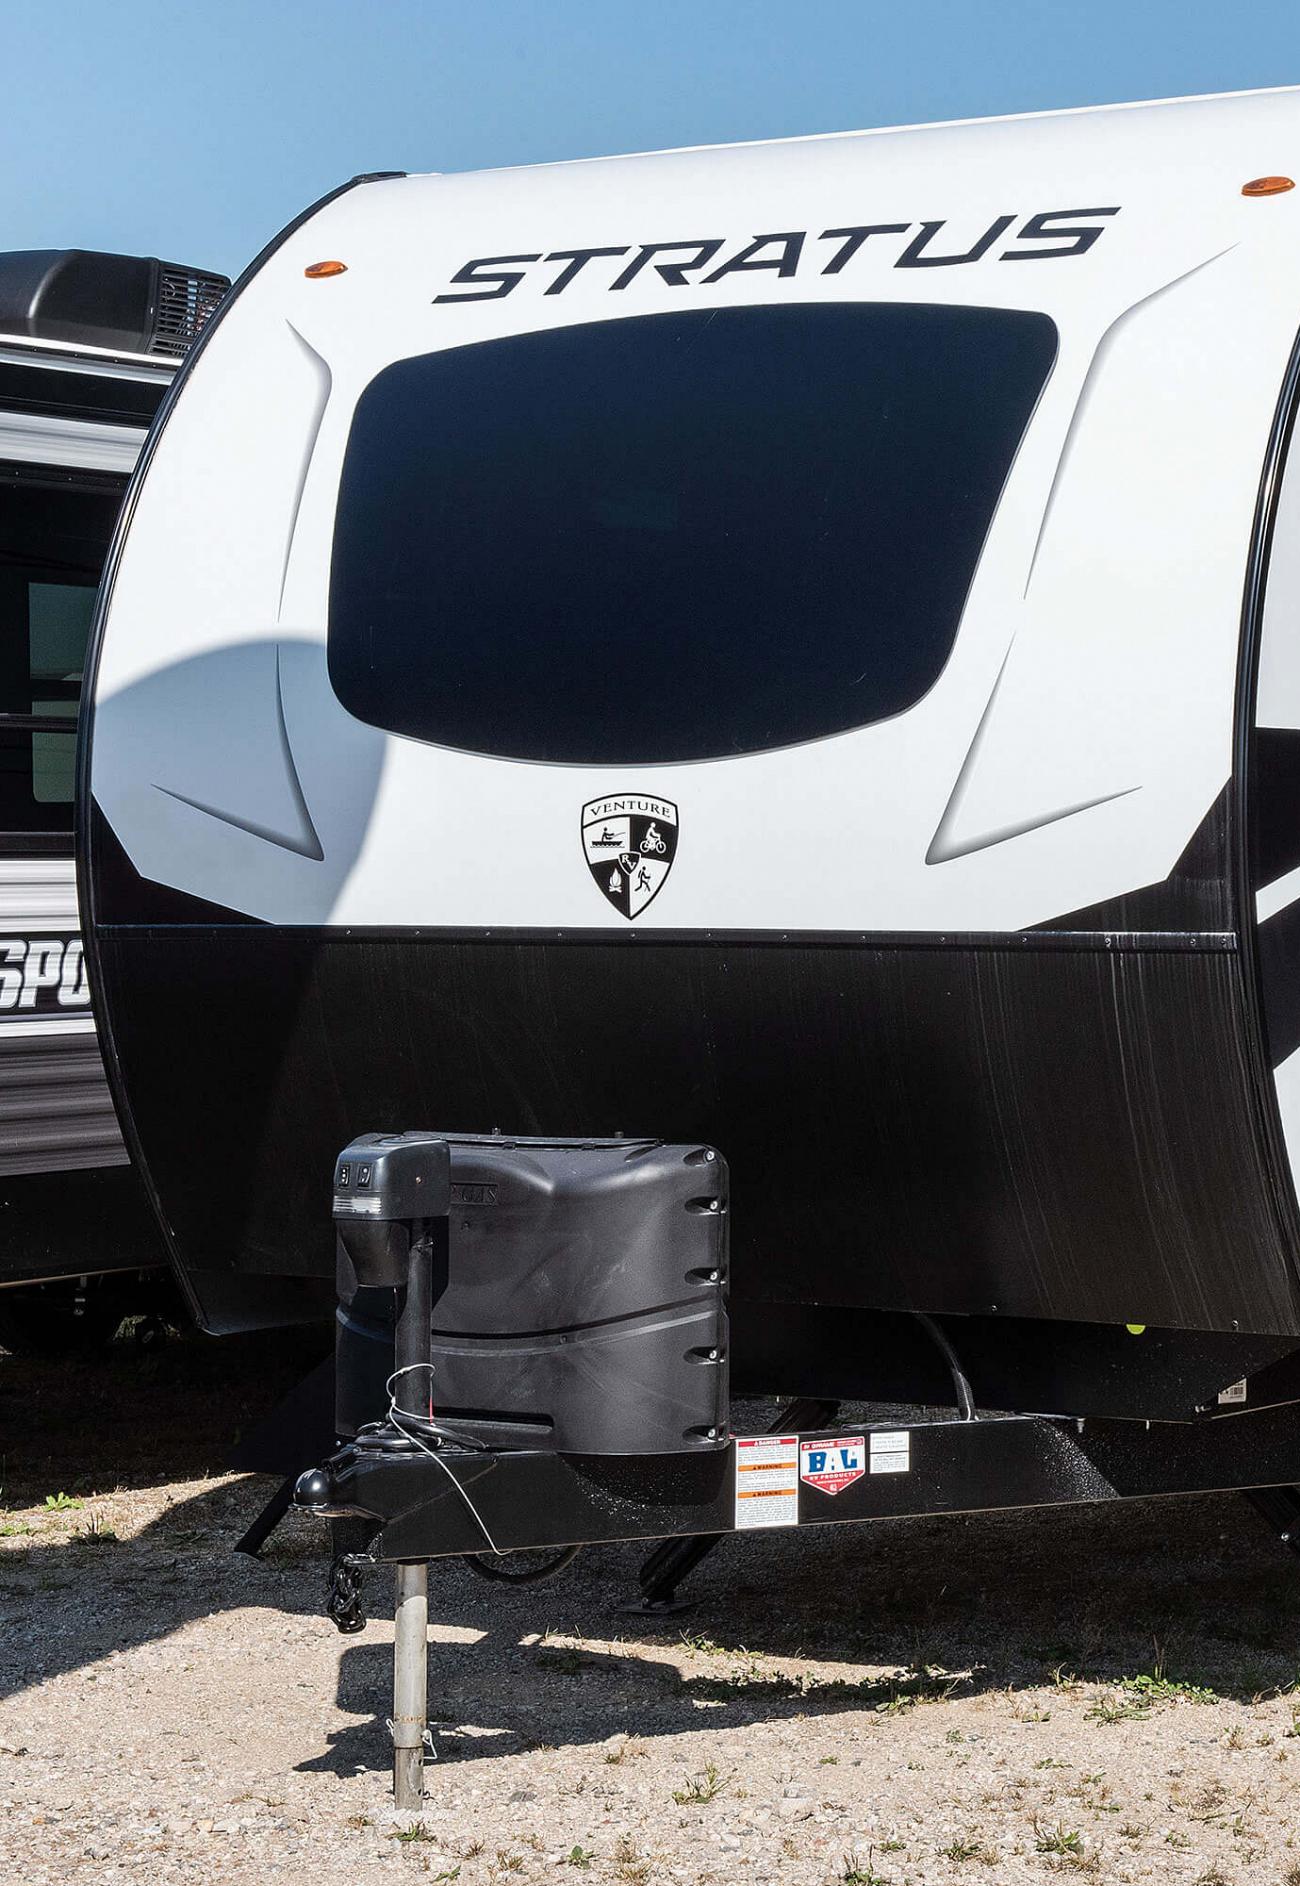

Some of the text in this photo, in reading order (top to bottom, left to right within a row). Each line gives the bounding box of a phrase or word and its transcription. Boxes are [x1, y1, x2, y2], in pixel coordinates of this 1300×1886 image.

[432, 207, 1121, 302] STRATUS
[590, 800, 671, 819] VENTURE
[757, 1463, 783, 1471] WARNING
[820, 1471, 857, 1480] PRODUCTS
